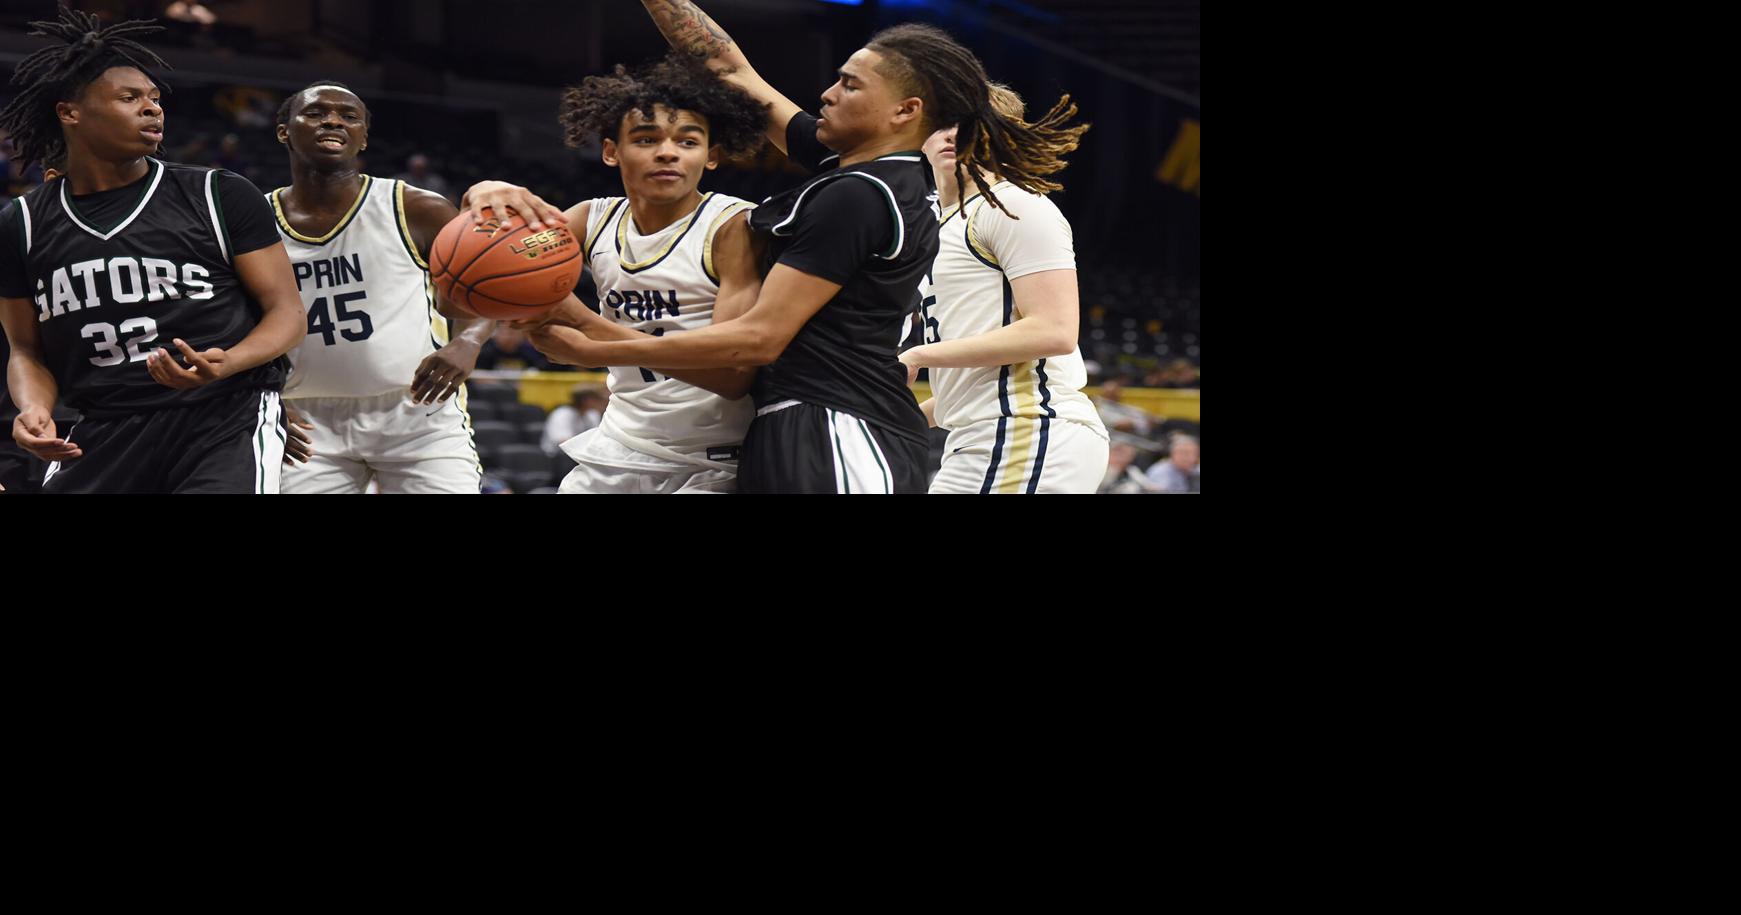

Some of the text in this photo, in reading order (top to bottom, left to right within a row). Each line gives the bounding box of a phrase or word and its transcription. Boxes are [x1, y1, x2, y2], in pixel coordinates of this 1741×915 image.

[510, 227, 569, 254] LEGA
[292, 253, 364, 292] PRIN
[306, 290, 374, 346] 45
[606, 289, 680, 321] PRIN
[80, 316, 160, 368] 32
